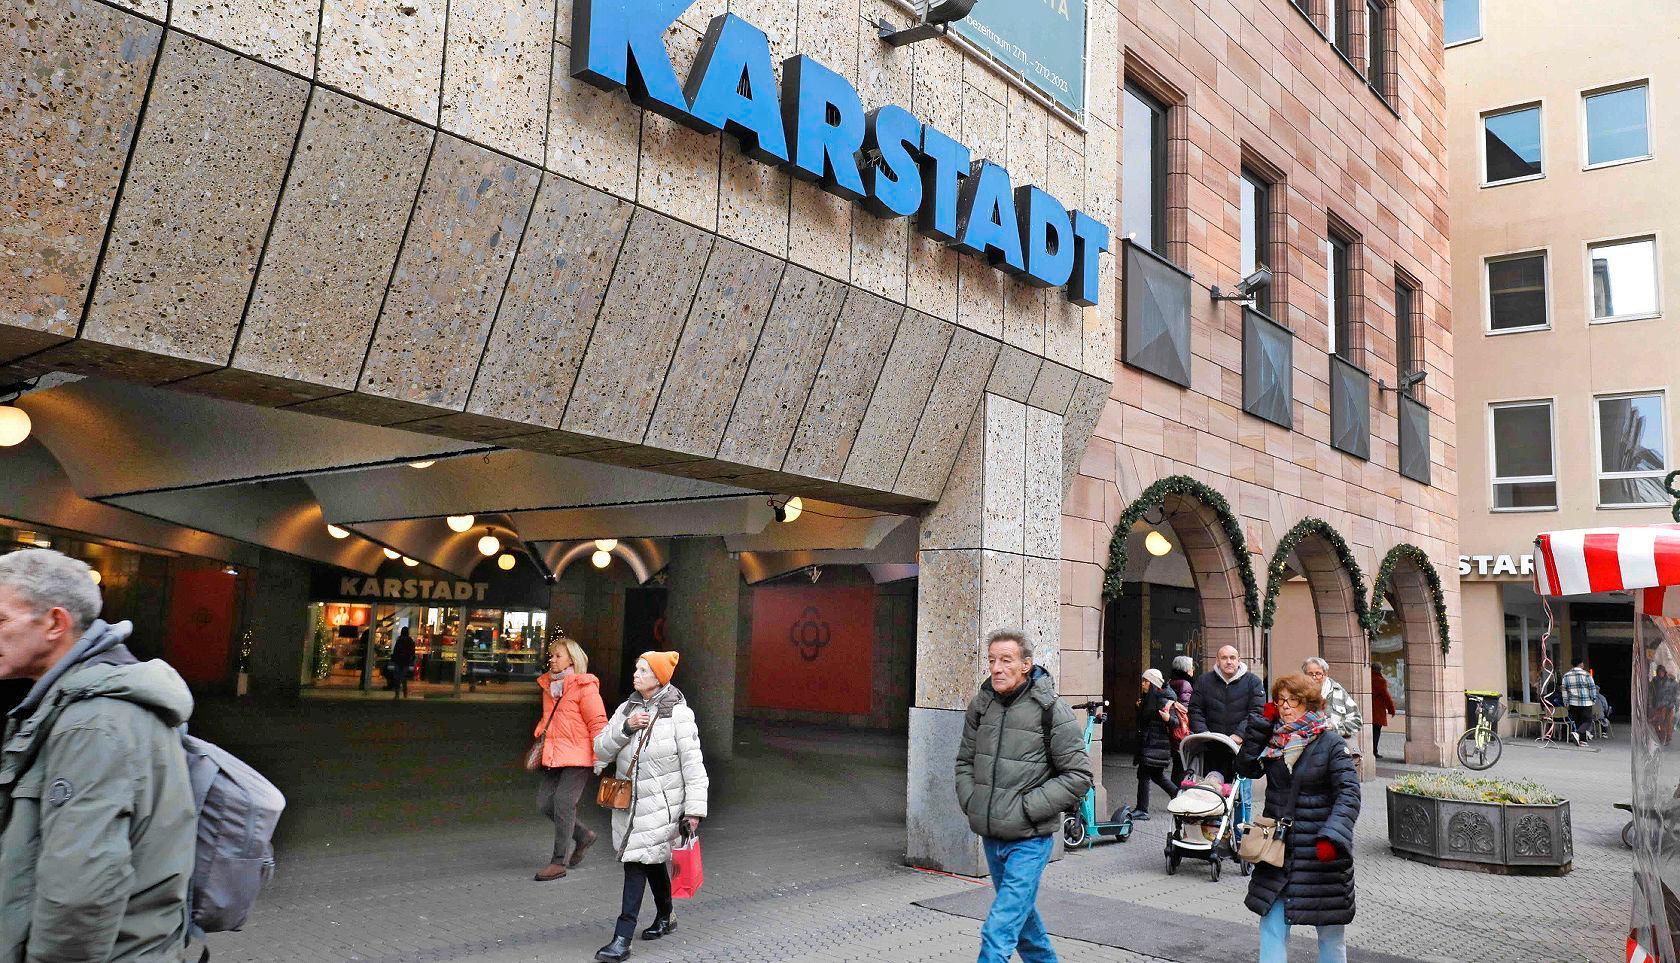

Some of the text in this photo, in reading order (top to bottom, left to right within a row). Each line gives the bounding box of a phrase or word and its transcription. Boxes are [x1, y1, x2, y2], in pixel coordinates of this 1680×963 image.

[964, 15, 1011, 53] bezeitraum
[572, 0, 1109, 307] KARSTADT
[340, 576, 489, 601] KARSTADT
